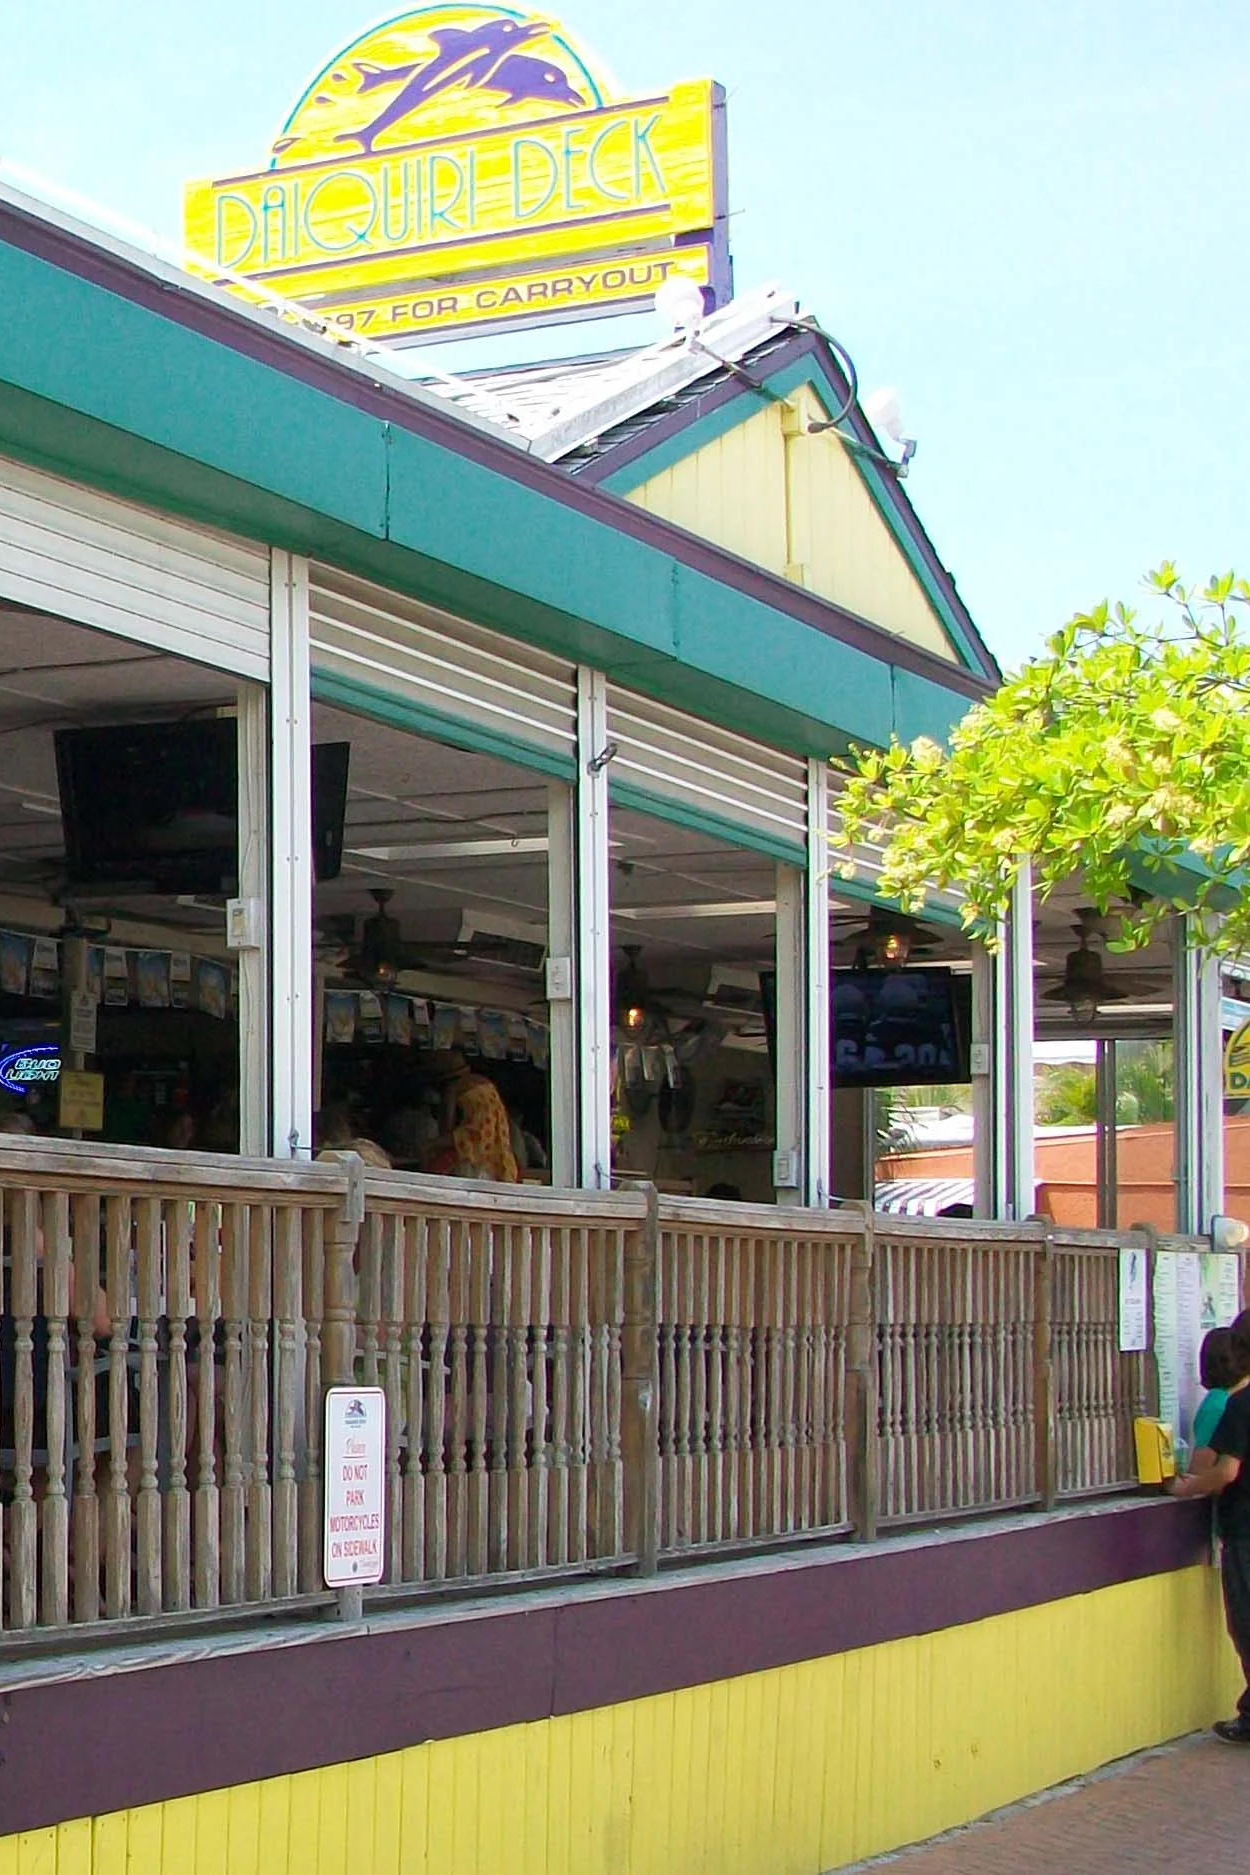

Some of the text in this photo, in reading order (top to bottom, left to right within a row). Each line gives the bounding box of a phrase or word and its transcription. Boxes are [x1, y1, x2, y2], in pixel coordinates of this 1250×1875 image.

[216, 113, 668, 270] DAIQUIRI DECK
[391, 296, 459, 324] FOR
[475, 260, 676, 309] CARRYOUT
[1229, 1071, 1250, 1091] D
[342, 1463, 368, 1481] DO NOT
[346, 1489, 365, 1507] PARK
[329, 1513, 380, 1533] MOTORCYCLES
[331, 1539, 378, 1558] ON SIDEWALK
